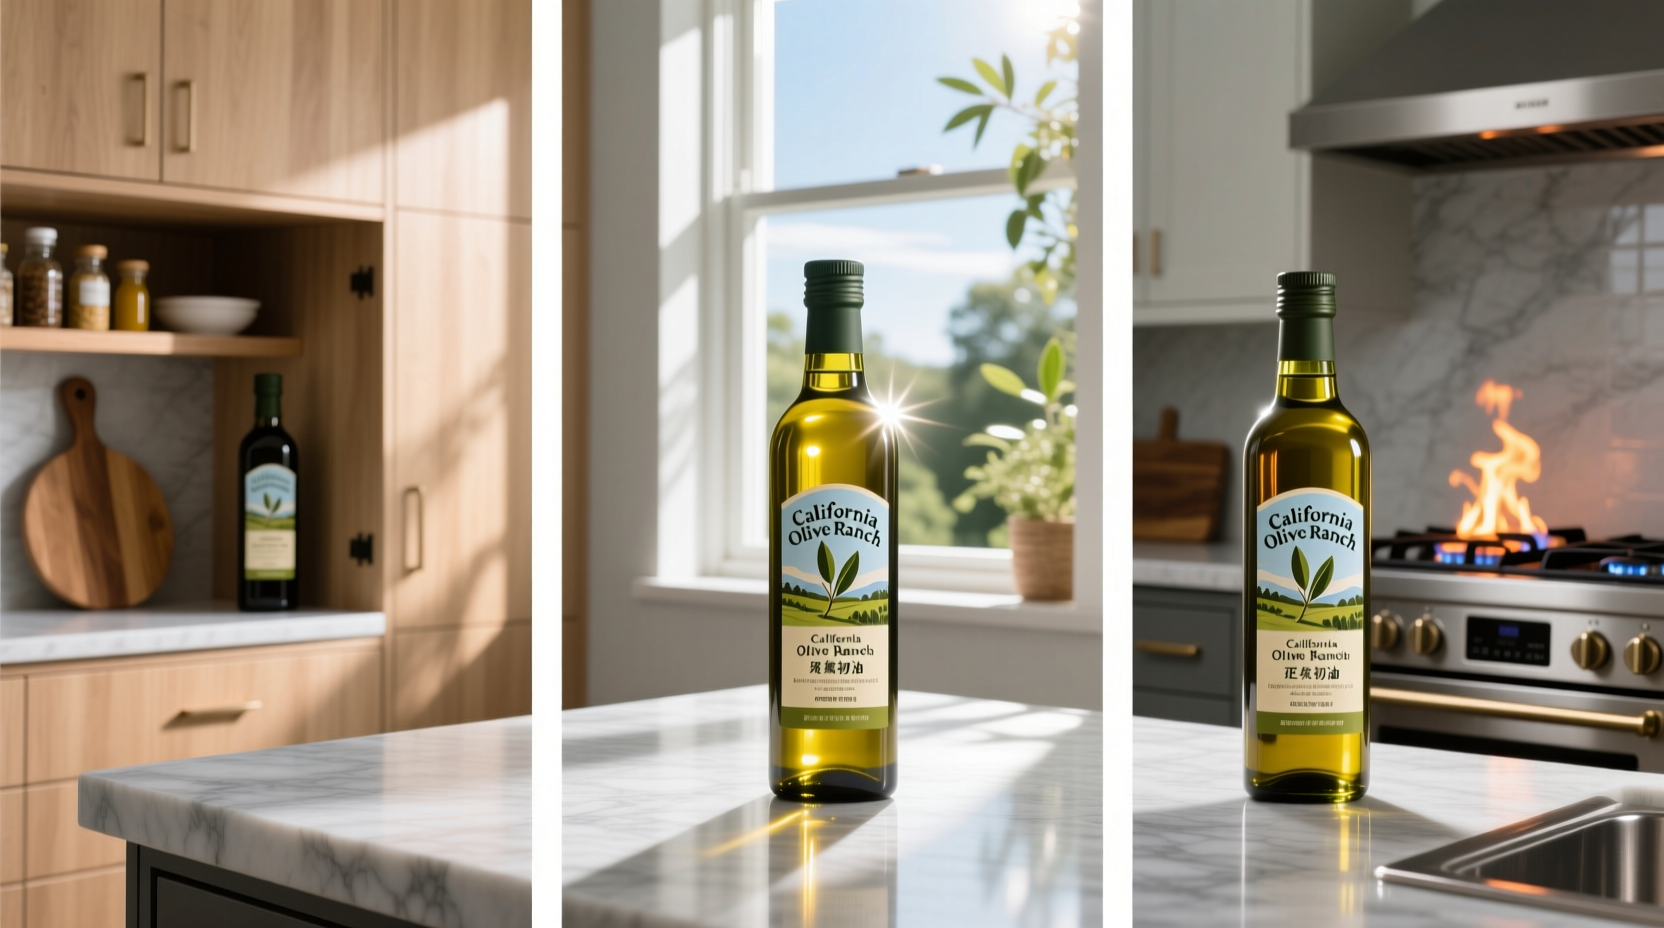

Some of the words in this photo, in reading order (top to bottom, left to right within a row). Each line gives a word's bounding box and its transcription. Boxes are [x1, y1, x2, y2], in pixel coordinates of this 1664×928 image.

[792, 501, 878, 529] California
[1268, 505, 1353, 531] California
[788, 525, 831, 546] Olive
[834, 521, 881, 547] Ranch
[1264, 528, 1307, 549] Olive
[1310, 525, 1356, 551] Ranch
